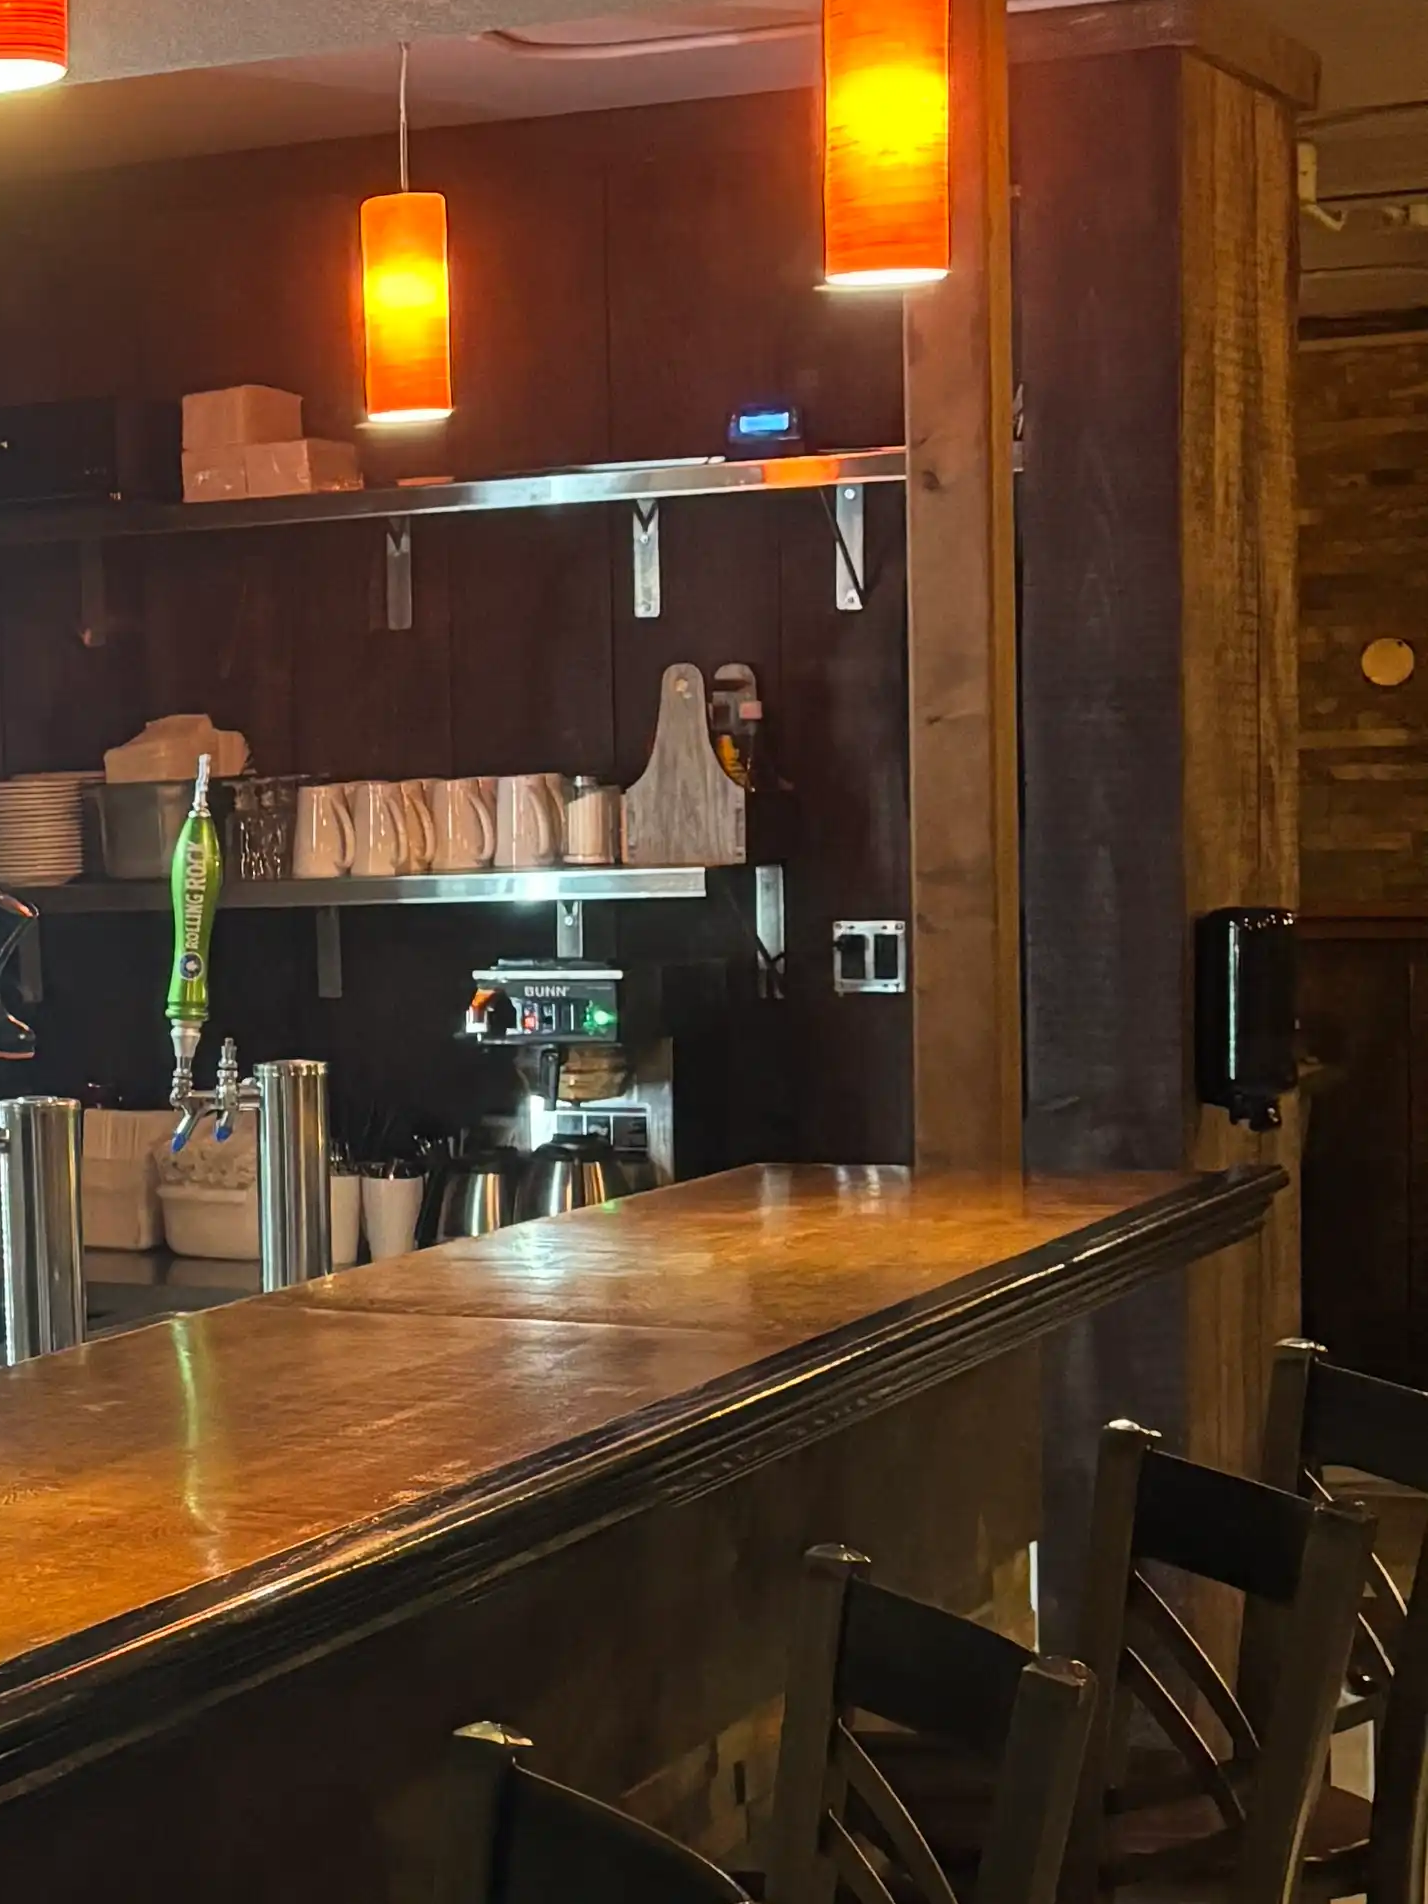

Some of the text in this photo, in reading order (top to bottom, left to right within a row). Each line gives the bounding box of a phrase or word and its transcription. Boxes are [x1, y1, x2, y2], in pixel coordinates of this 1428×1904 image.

[184, 840, 207, 950] ROLLING ROCK
[524, 985, 568, 997] BUNN
